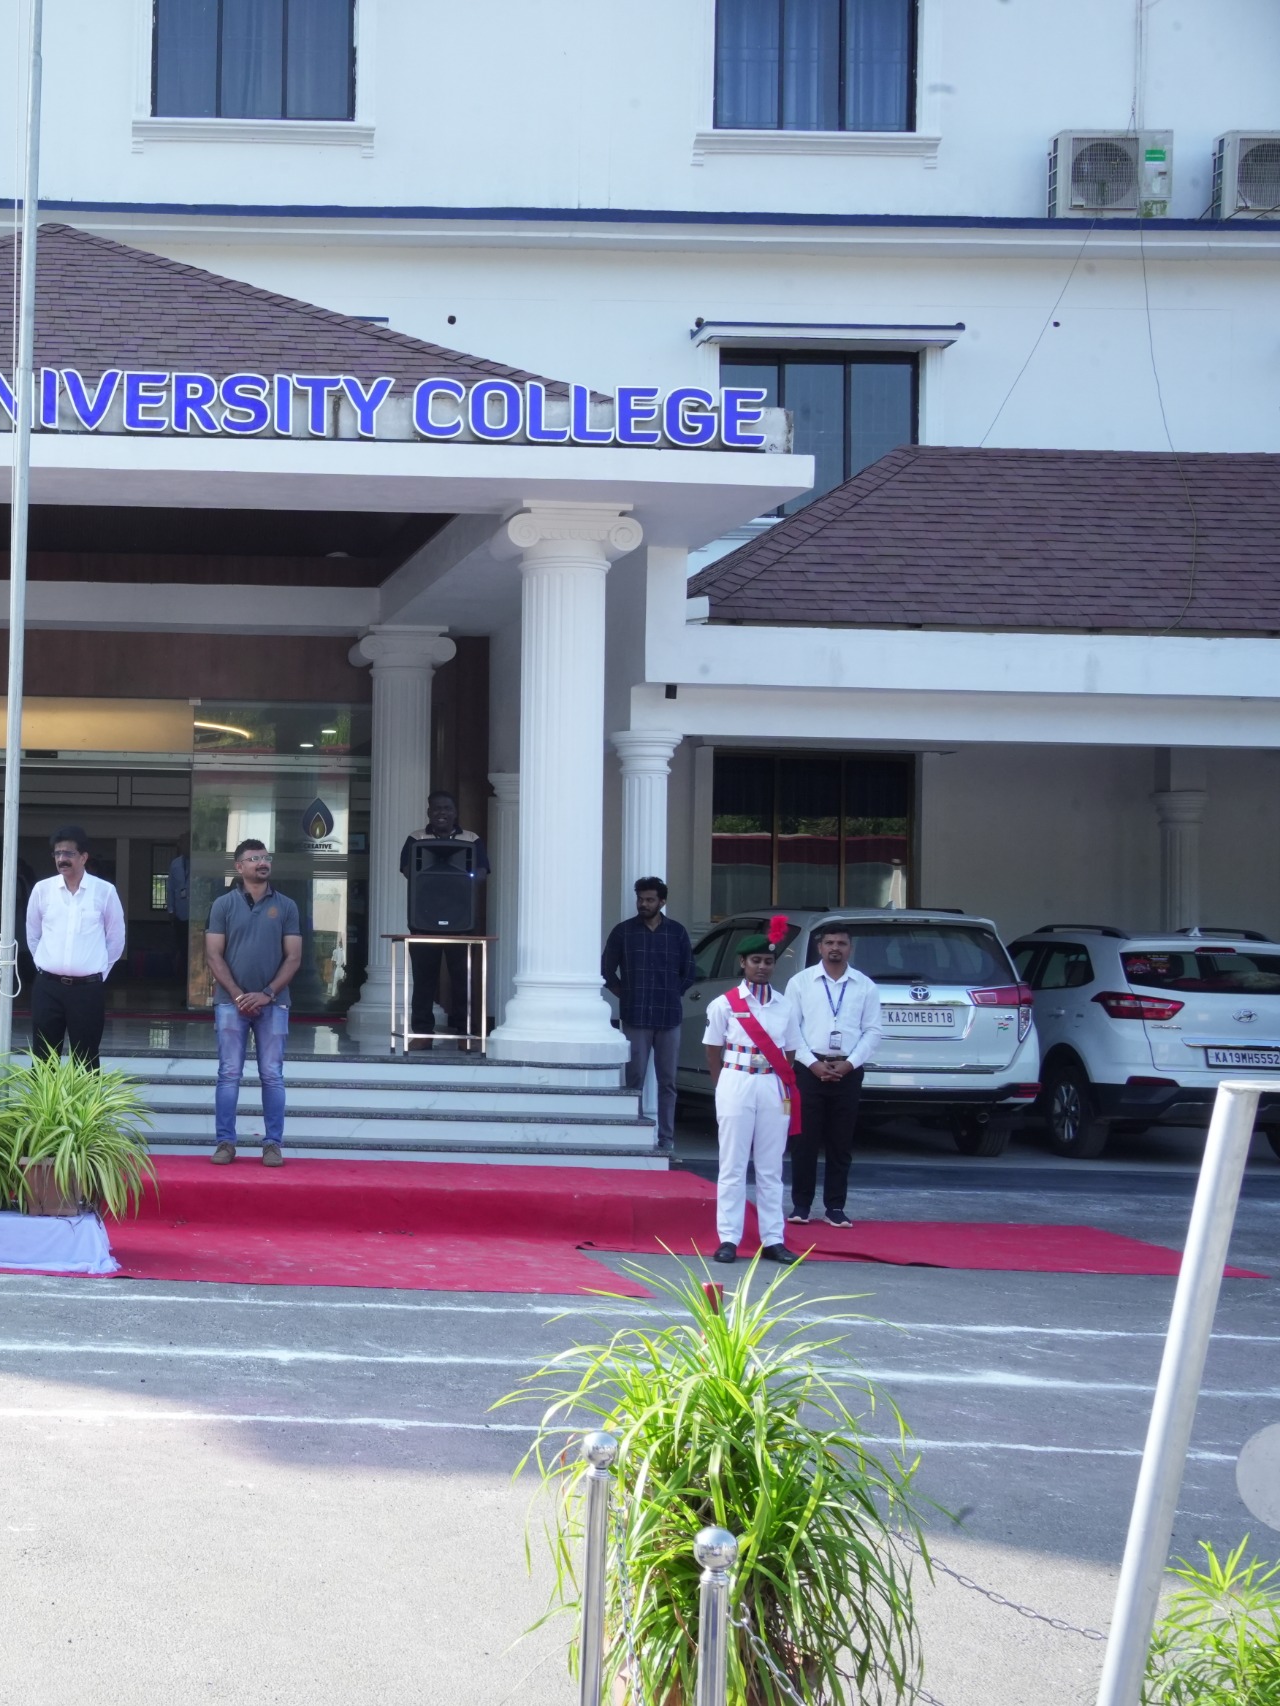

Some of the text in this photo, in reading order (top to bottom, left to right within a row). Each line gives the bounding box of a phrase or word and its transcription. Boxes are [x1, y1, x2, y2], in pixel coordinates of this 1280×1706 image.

[412, 377, 768, 448] COLLEGE
[887, 1011, 953, 1023] KA20ME8118
[1215, 1051, 1280, 1065] KA19MH5552
